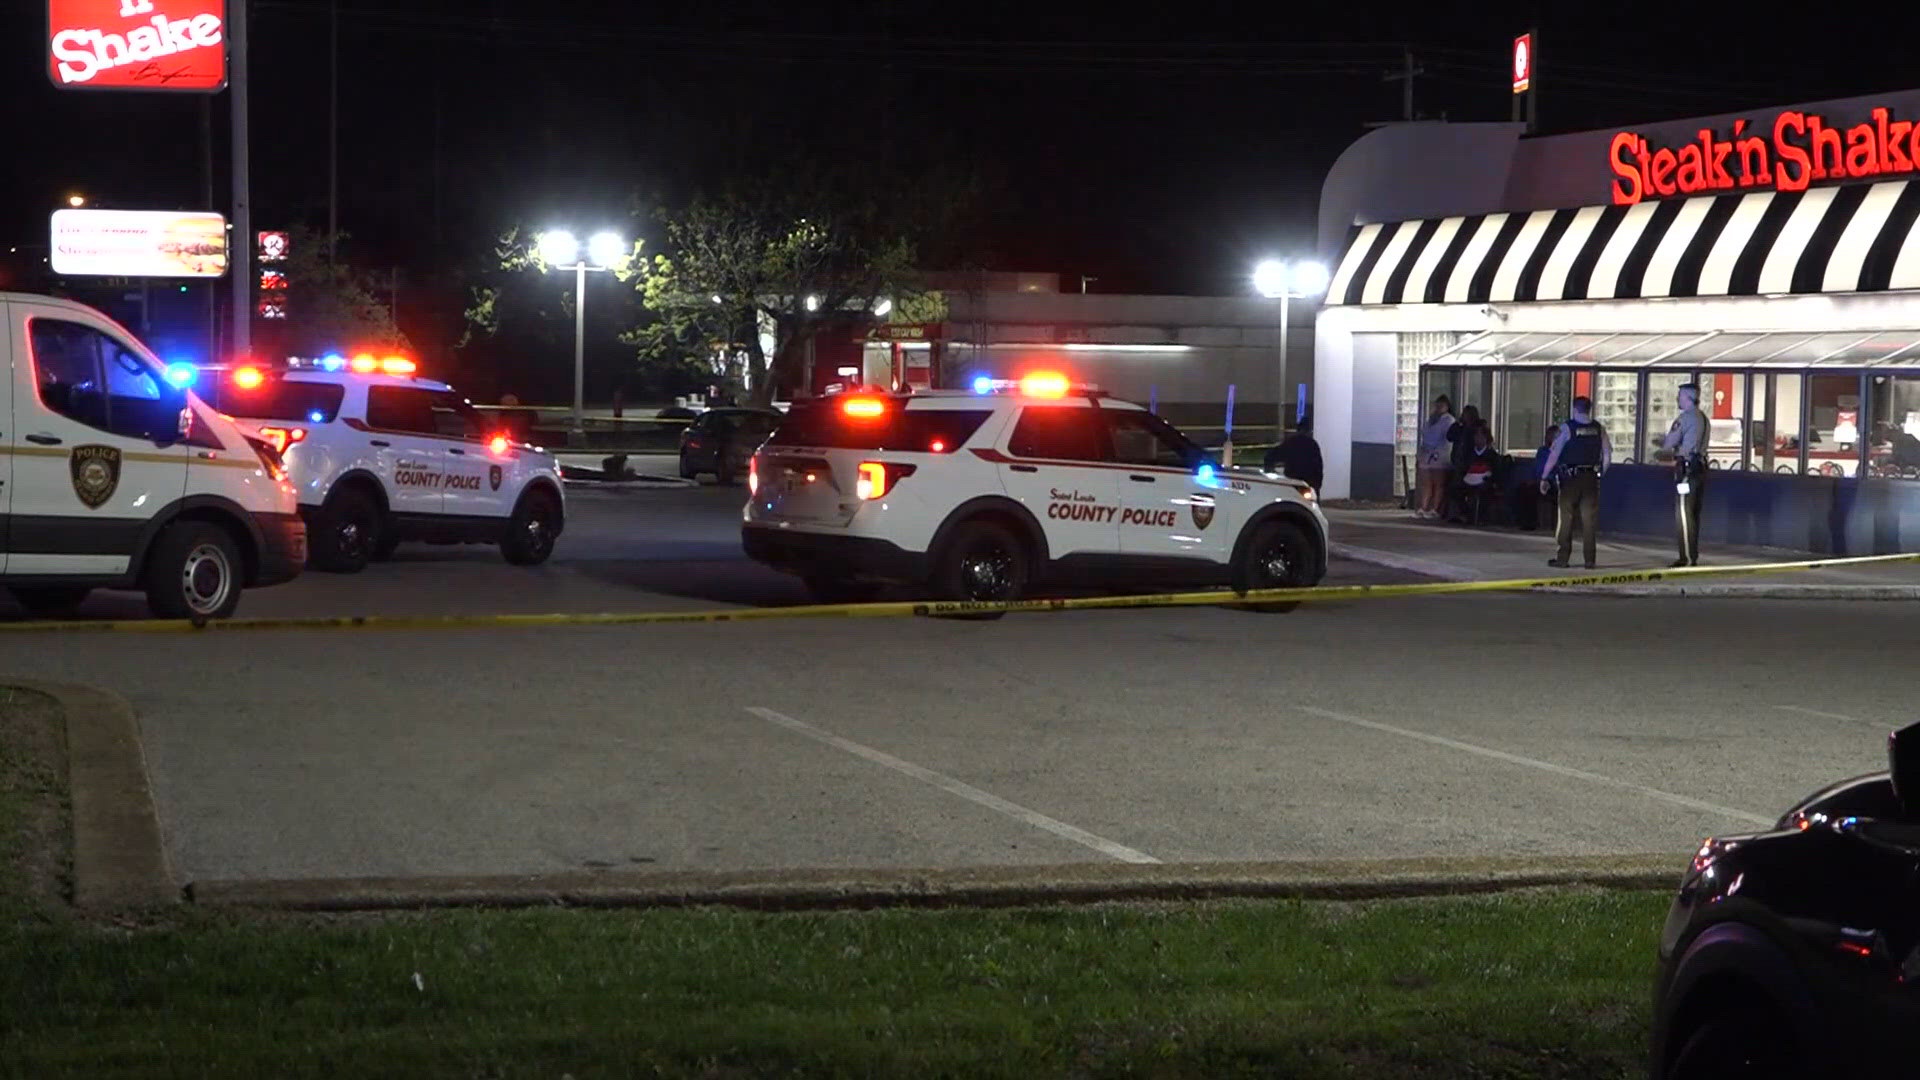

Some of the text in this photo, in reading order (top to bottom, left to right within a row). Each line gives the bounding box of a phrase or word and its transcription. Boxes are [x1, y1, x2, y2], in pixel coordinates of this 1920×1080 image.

[52, 13, 222, 84] Shake
[75, 447, 119, 461] POLICE
[394, 470, 481, 490] COUNTY POLICE
[1050, 488, 1096, 503] Saint Louis
[1047, 503, 1176, 527] COUNTY POLICE
